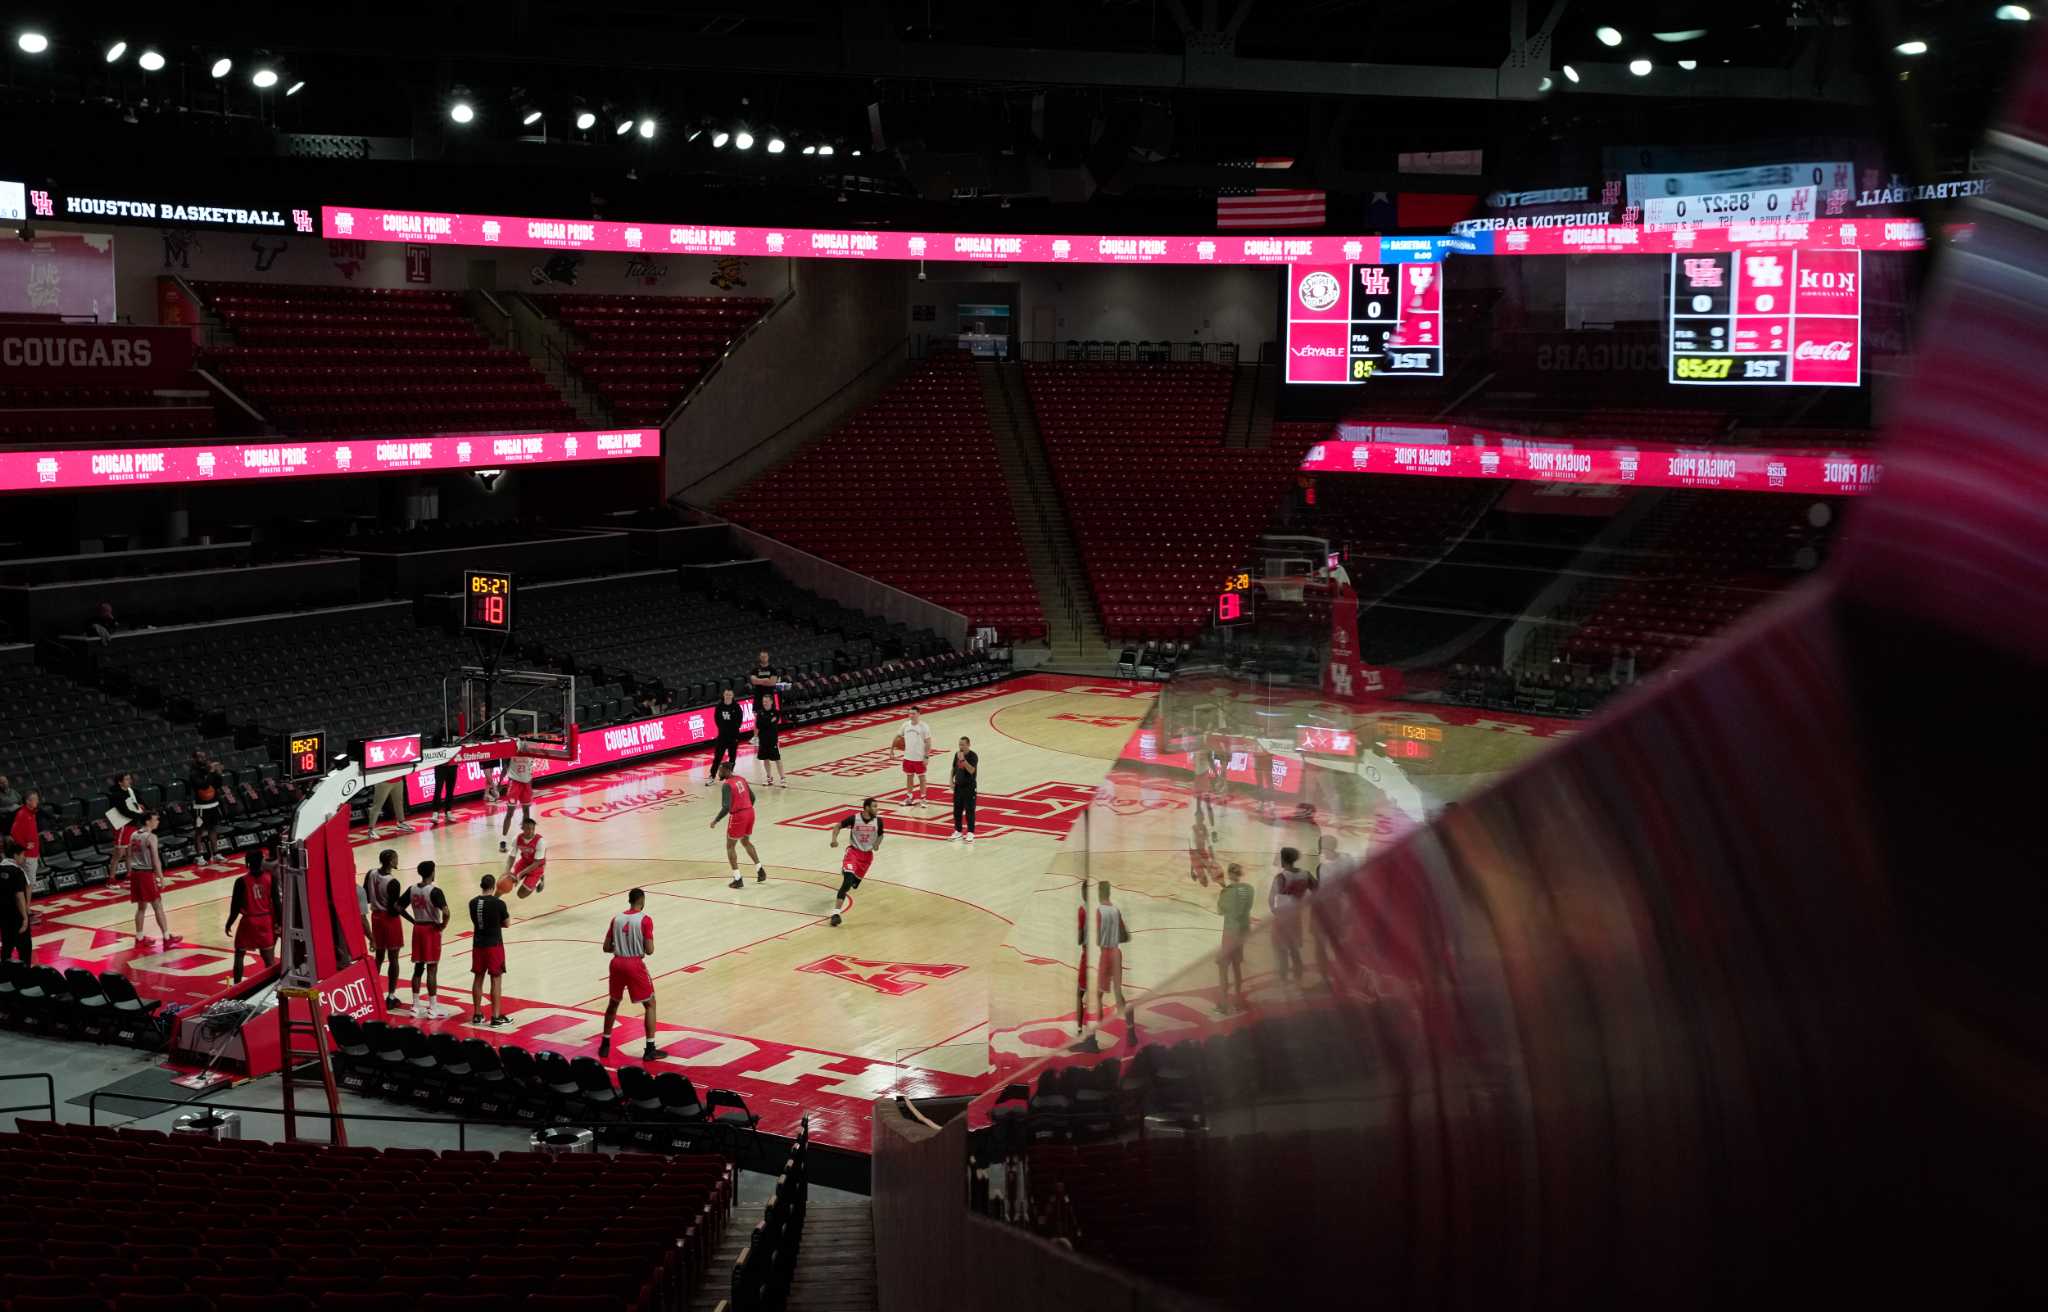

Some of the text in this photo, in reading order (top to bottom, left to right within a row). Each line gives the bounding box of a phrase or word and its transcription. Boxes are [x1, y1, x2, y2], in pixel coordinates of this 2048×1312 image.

[31, 190, 53, 216] UH
[67, 197, 285, 226] HOUSTON BASKETBALL
[292, 209, 313, 232] UH
[383, 214, 452, 235] COUGAR PRIDE
[528, 221, 595, 242] COUGAR PRIDE
[670, 228, 737, 247] COUGAR PRIDE
[812, 233, 879, 251] COUGAR PRIDE
[954, 236, 1022, 254] COUGAR PRIDE
[1099, 239, 1167, 255] COUGAR PRIDE
[1243, 239, 1313, 256] COUGAR PRIDE
[1360, 267, 1390, 295] UH
[1367, 302, 1382, 318] 0
[2, 336, 153, 368] COUGARS
[1676, 358, 1733, 379] 85:27
[494, 438, 544, 456] COUGAR PRIDE
[597, 433, 643, 450] COUGAR PRIDE
[244, 447, 308, 467] COUGAR PRIDE
[376, 442, 433, 461] COUGAR PRIDE
[92, 453, 165, 475] COUGAR PRIDE
[472, 576, 508, 594] 85:27
[485, 596, 503, 624] 18
[292, 738, 318, 753] 85:27
[604, 729, 639, 752] COUGAR
[640, 720, 666, 744] PRIDE
[301, 753, 313, 770] 18
[621, 922, 630, 935] 4
